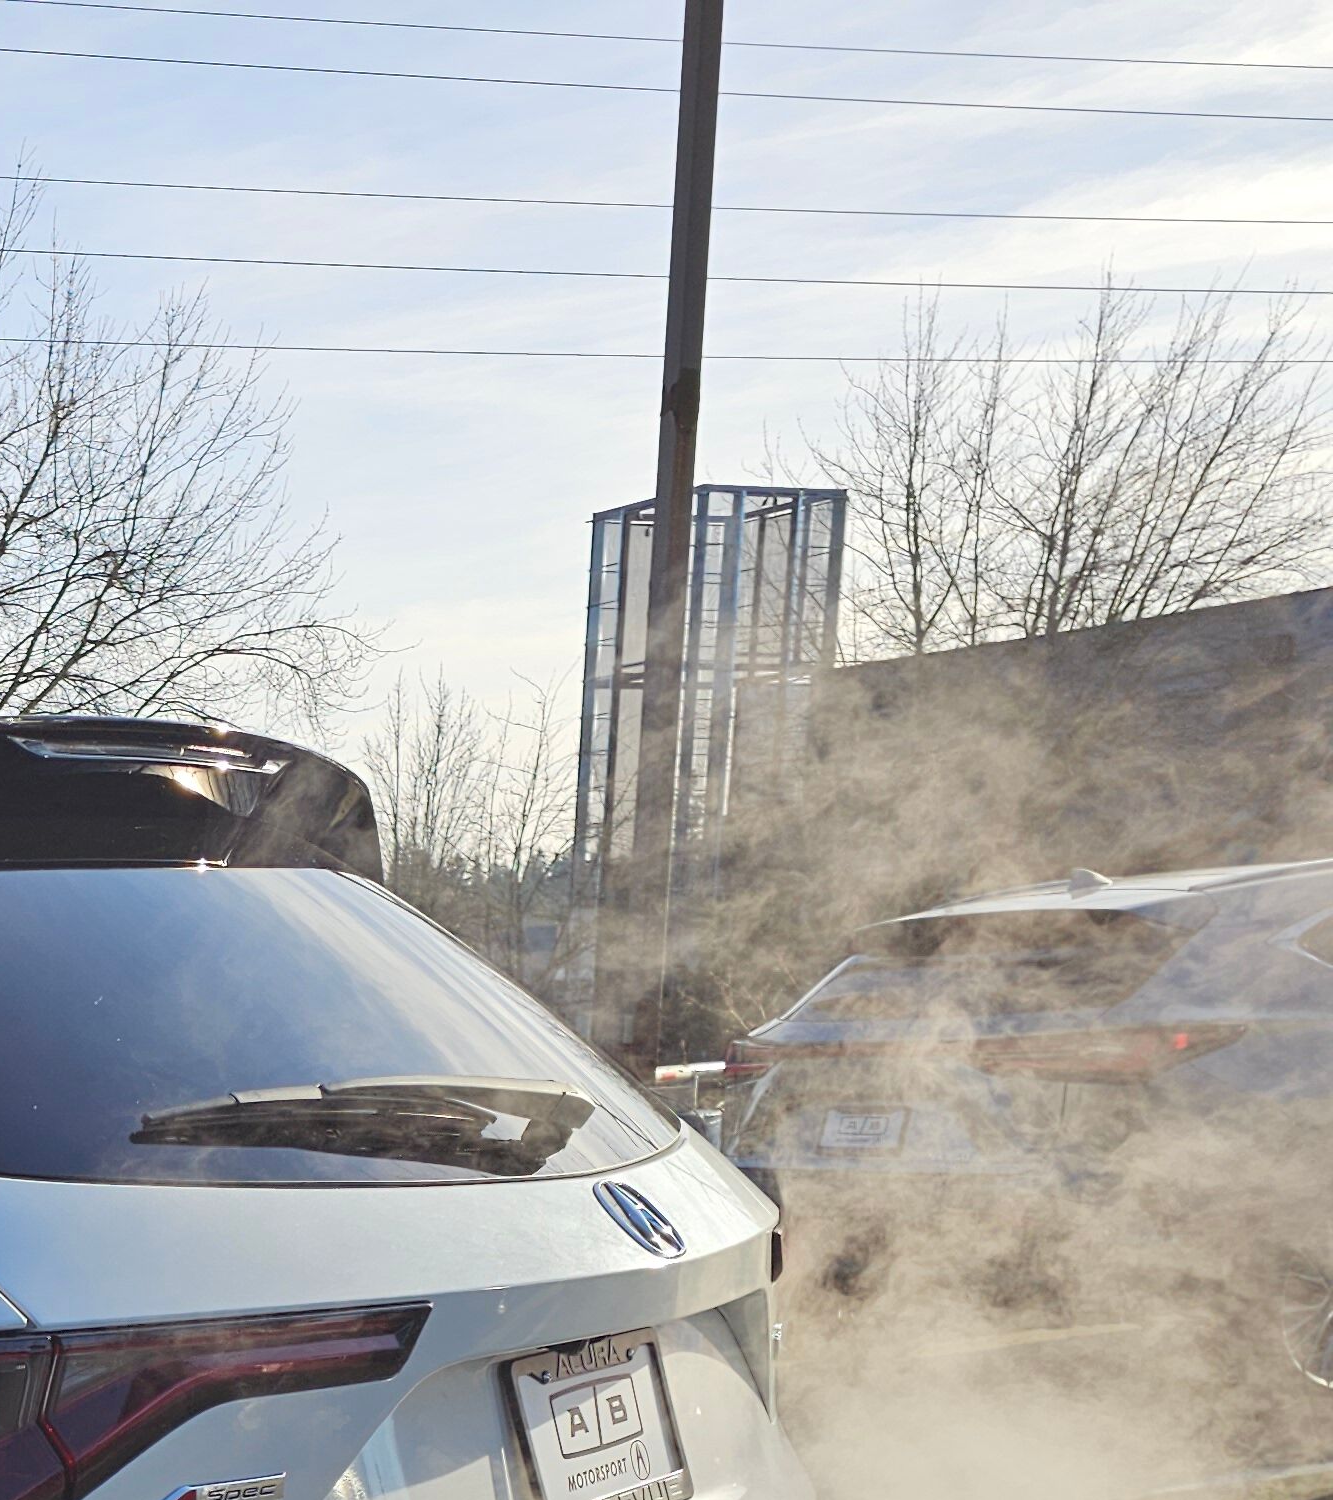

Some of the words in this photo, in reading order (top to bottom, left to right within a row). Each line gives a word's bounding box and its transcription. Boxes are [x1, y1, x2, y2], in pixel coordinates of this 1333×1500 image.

[557, 1339, 621, 1377] ACURA
[568, 1406, 589, 1437] A
[606, 1394, 628, 1425] B
[567, 1457, 628, 1492] MOTORSPORT
